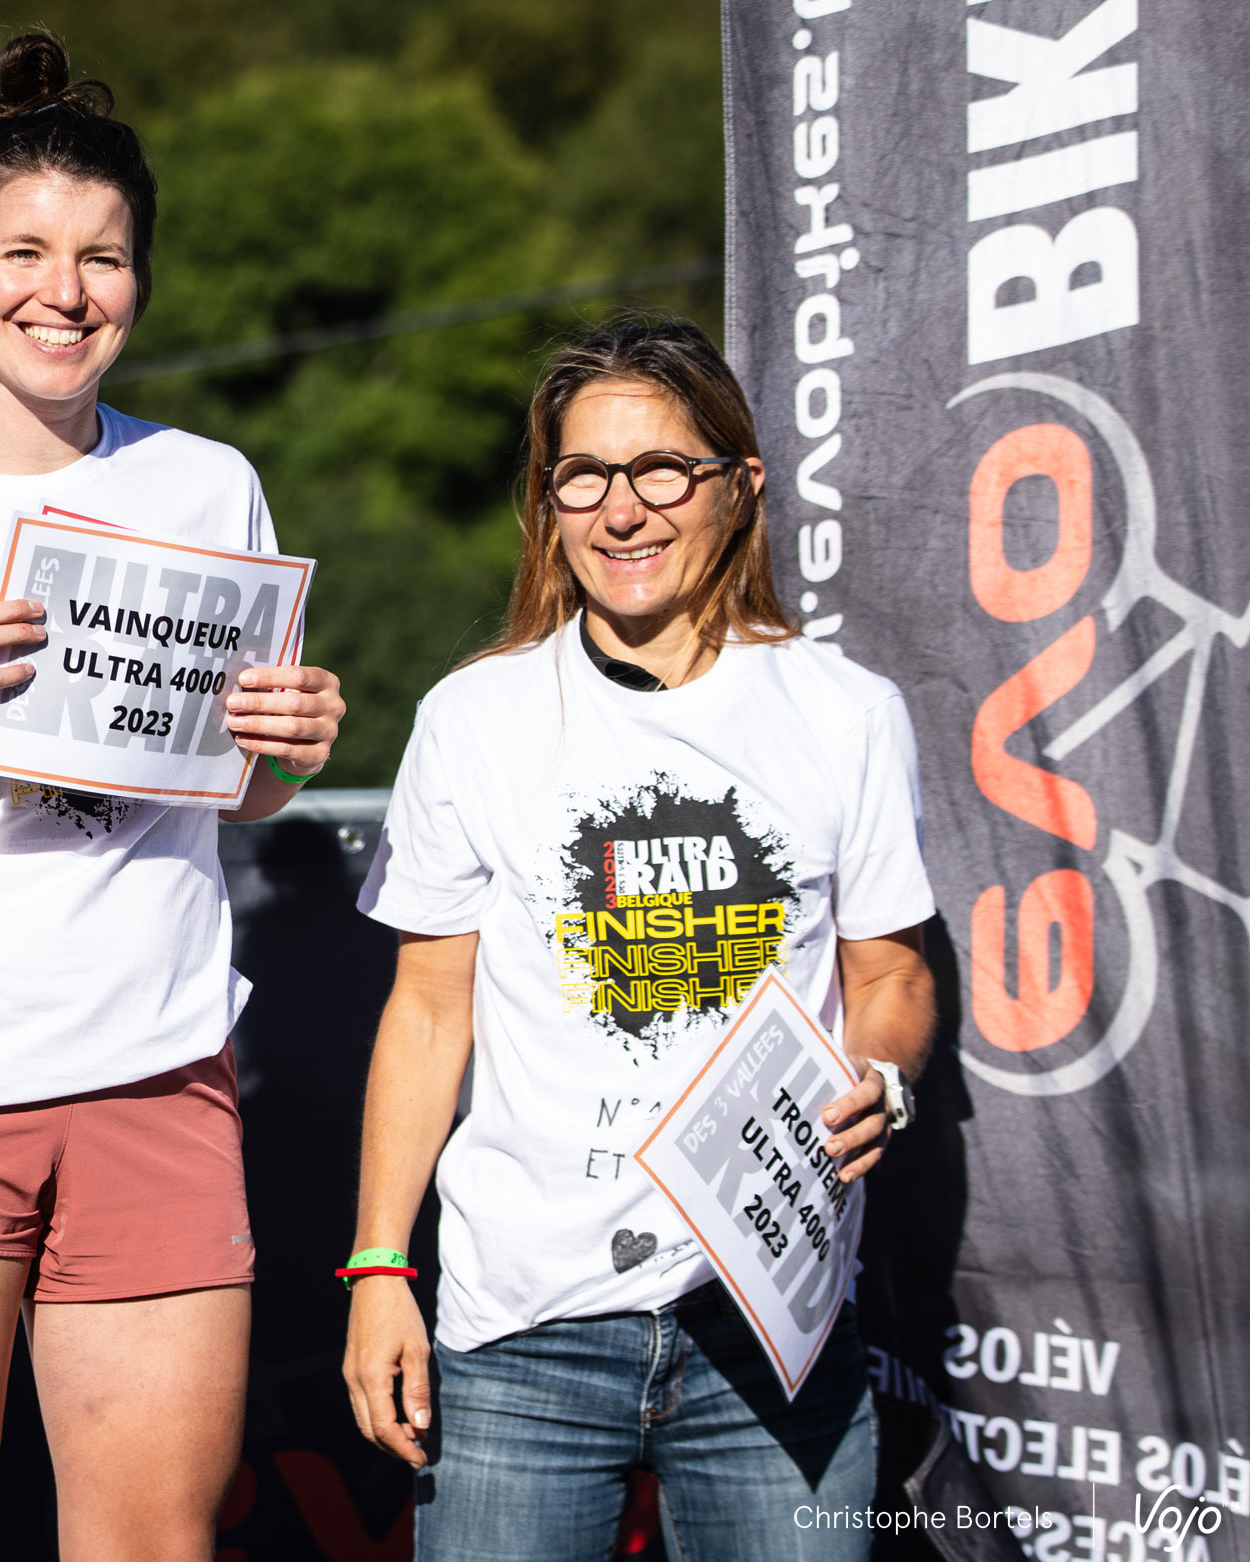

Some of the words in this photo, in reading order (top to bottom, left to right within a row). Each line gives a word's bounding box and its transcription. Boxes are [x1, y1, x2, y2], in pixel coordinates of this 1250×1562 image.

[50, 547, 280, 664] ULTRA
[69, 599, 241, 651] VAINQUEUR
[62, 647, 163, 689] ULTRA
[170, 666, 227, 696] 4000
[109, 705, 174, 737] 2023
[627, 836, 735, 865] ULTRA
[627, 860, 739, 895] RAID
[616, 892, 693, 909] BELGIQUE
[555, 902, 787, 943] FINISHER
[557, 936, 790, 979] FINISHER
[561, 970, 788, 1013] FINISHE
[683, 1114, 718, 1155] DES
[714, 1096, 728, 1117] 3
[726, 1024, 784, 1098] VALLEES
[586, 1147, 626, 1181] ET
[741, 1116, 802, 1208] ULTRA
[798, 1204, 831, 1262] 4000
[743, 1193, 789, 1258] 2023
